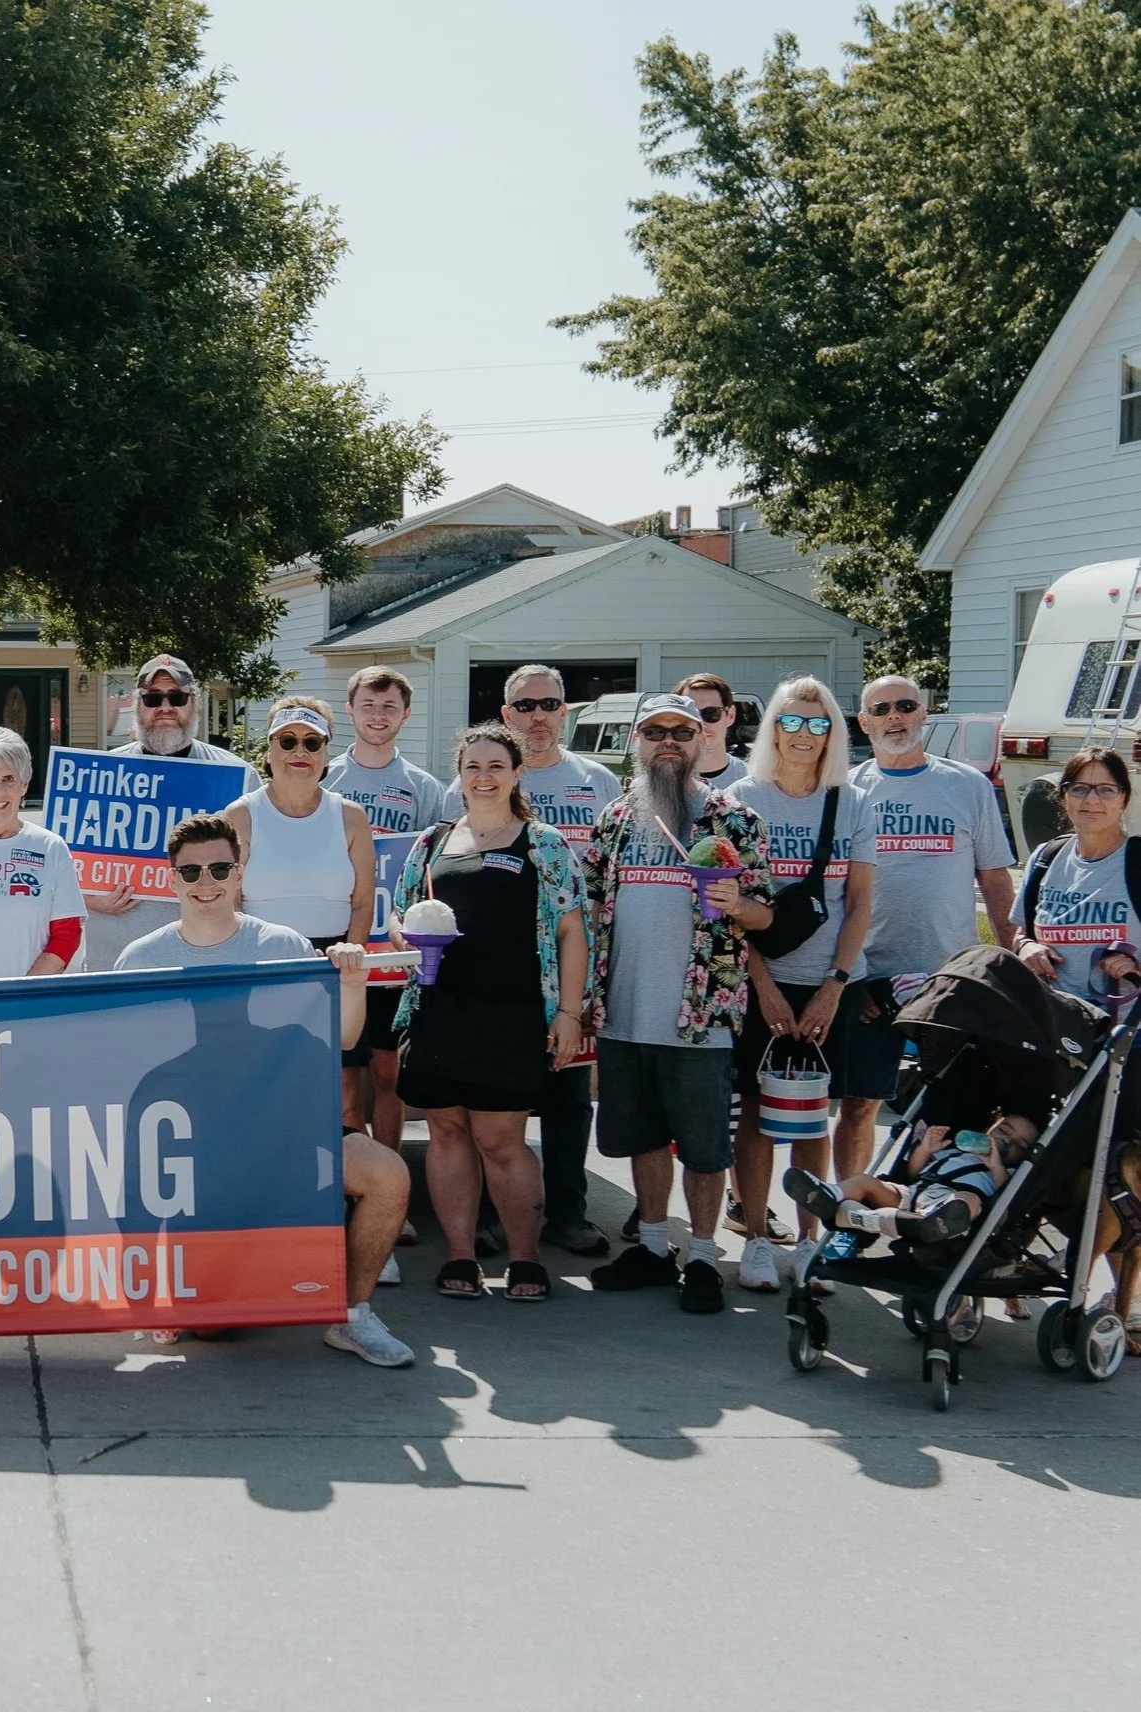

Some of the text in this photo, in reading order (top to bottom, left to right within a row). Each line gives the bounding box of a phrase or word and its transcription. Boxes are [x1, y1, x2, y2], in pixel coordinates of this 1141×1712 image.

[56, 758, 165, 799] Brinker
[340, 790, 377, 804] nker
[875, 800, 913, 813] nker
[52, 797, 224, 852] HARDI
[365, 805, 411, 832] DING
[876, 814, 955, 836] RDING
[563, 829, 591, 840] UNCIL
[768, 822, 811, 837] inker
[770, 837, 851, 860] ARDNG
[876, 838, 951, 850] CITY COUNCIL
[91, 860, 136, 886] CITY
[778, 863, 803, 874] CITY
[627, 870, 650, 881] CITY
[650, 870, 692, 884] COUNCI
[1040, 886, 1090, 904] rinker
[1043, 928, 1124, 941] CITY COUNCIL
